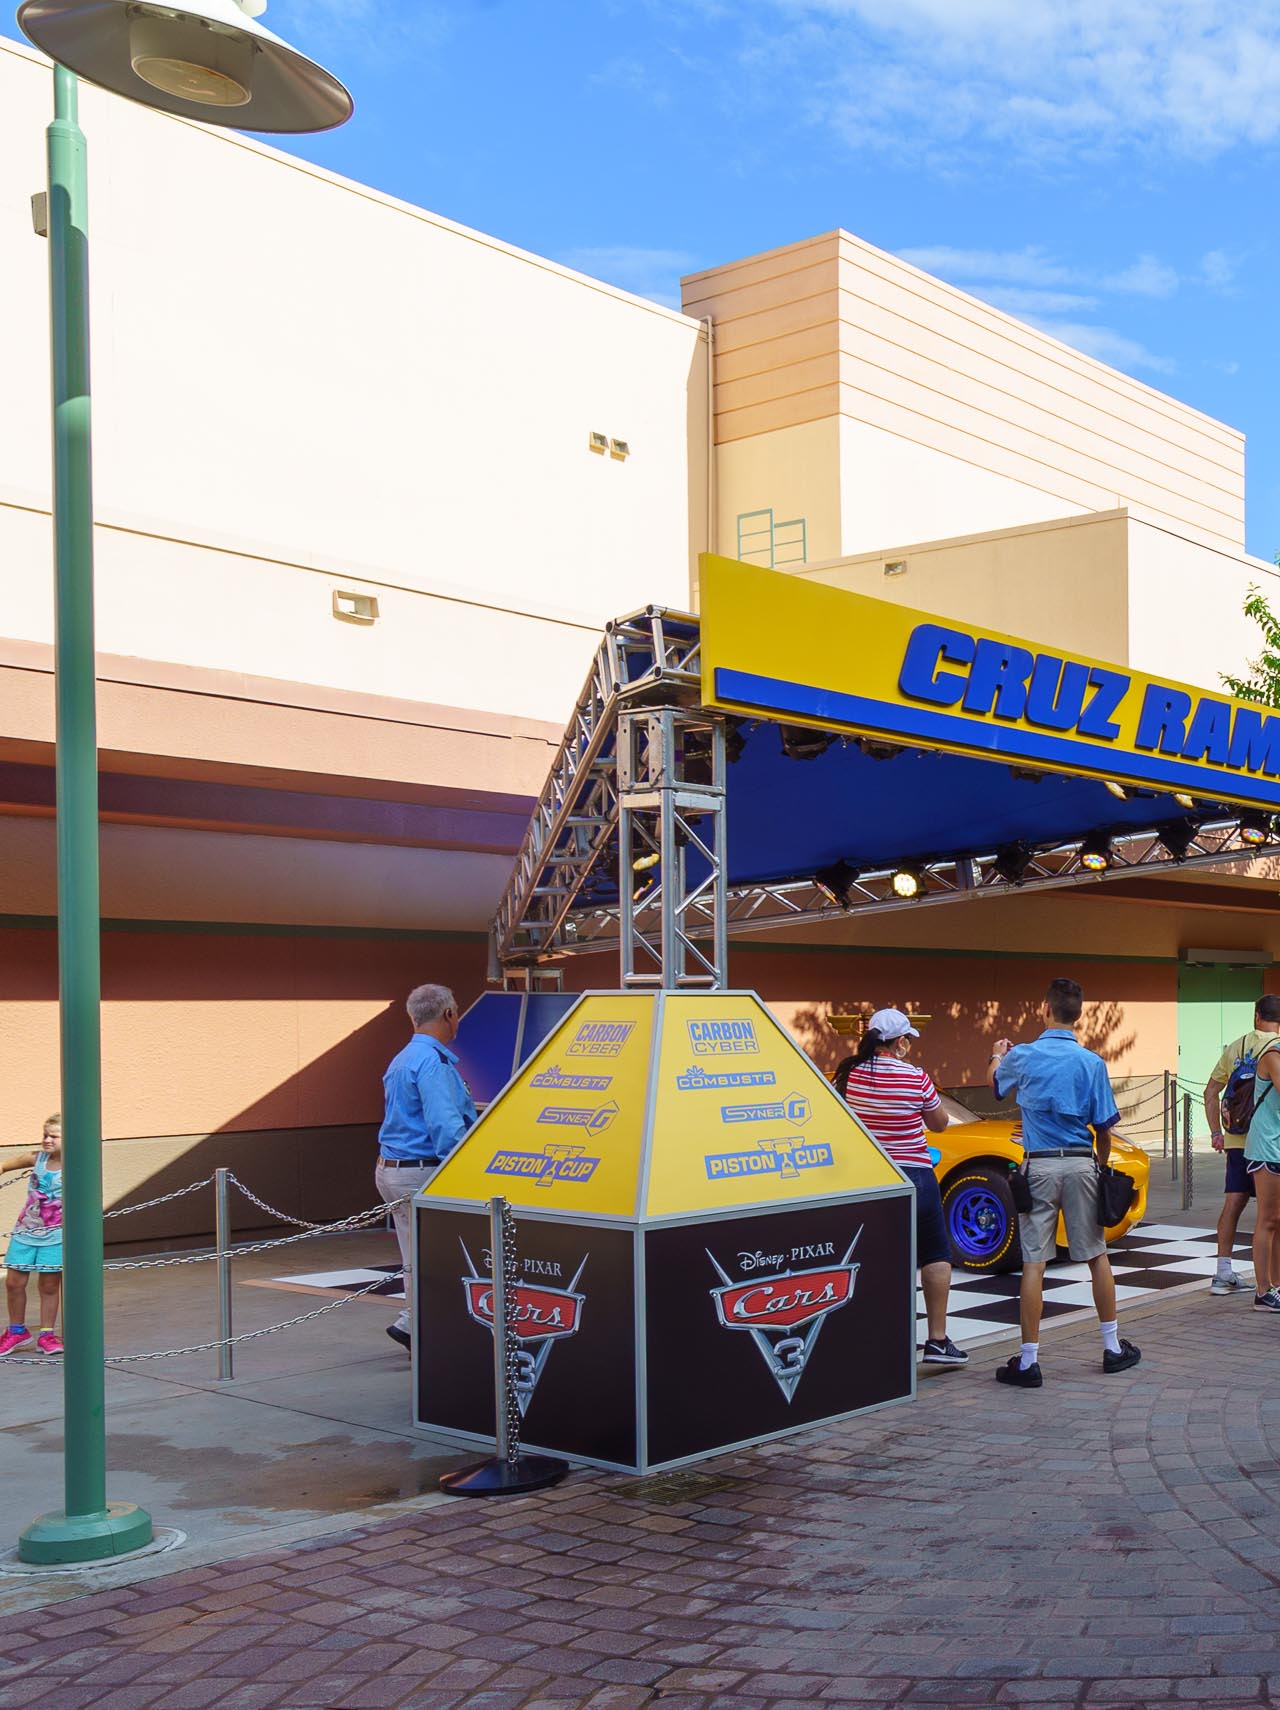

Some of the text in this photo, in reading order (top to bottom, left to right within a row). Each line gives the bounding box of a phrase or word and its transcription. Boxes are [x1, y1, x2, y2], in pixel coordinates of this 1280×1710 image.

[898, 623, 1131, 742] CRUZ
[575, 1023, 632, 1043] CARBON
[690, 1022, 754, 1041] CARBON
[568, 1043, 621, 1054] CYBER
[694, 1040, 757, 1053] CYBER
[532, 1075, 610, 1088] COMBUSTR
[678, 1074, 774, 1088] COMBUSTR
[491, 1155, 593, 1178] PISTON CUP
[710, 1148, 829, 1175] PISTON CUP
[791, 1242, 835, 1261] PIXAR
[523, 1258, 562, 1277] PIXAR
[733, 1282, 838, 1318] Cars
[774, 1337, 805, 1379] 3
